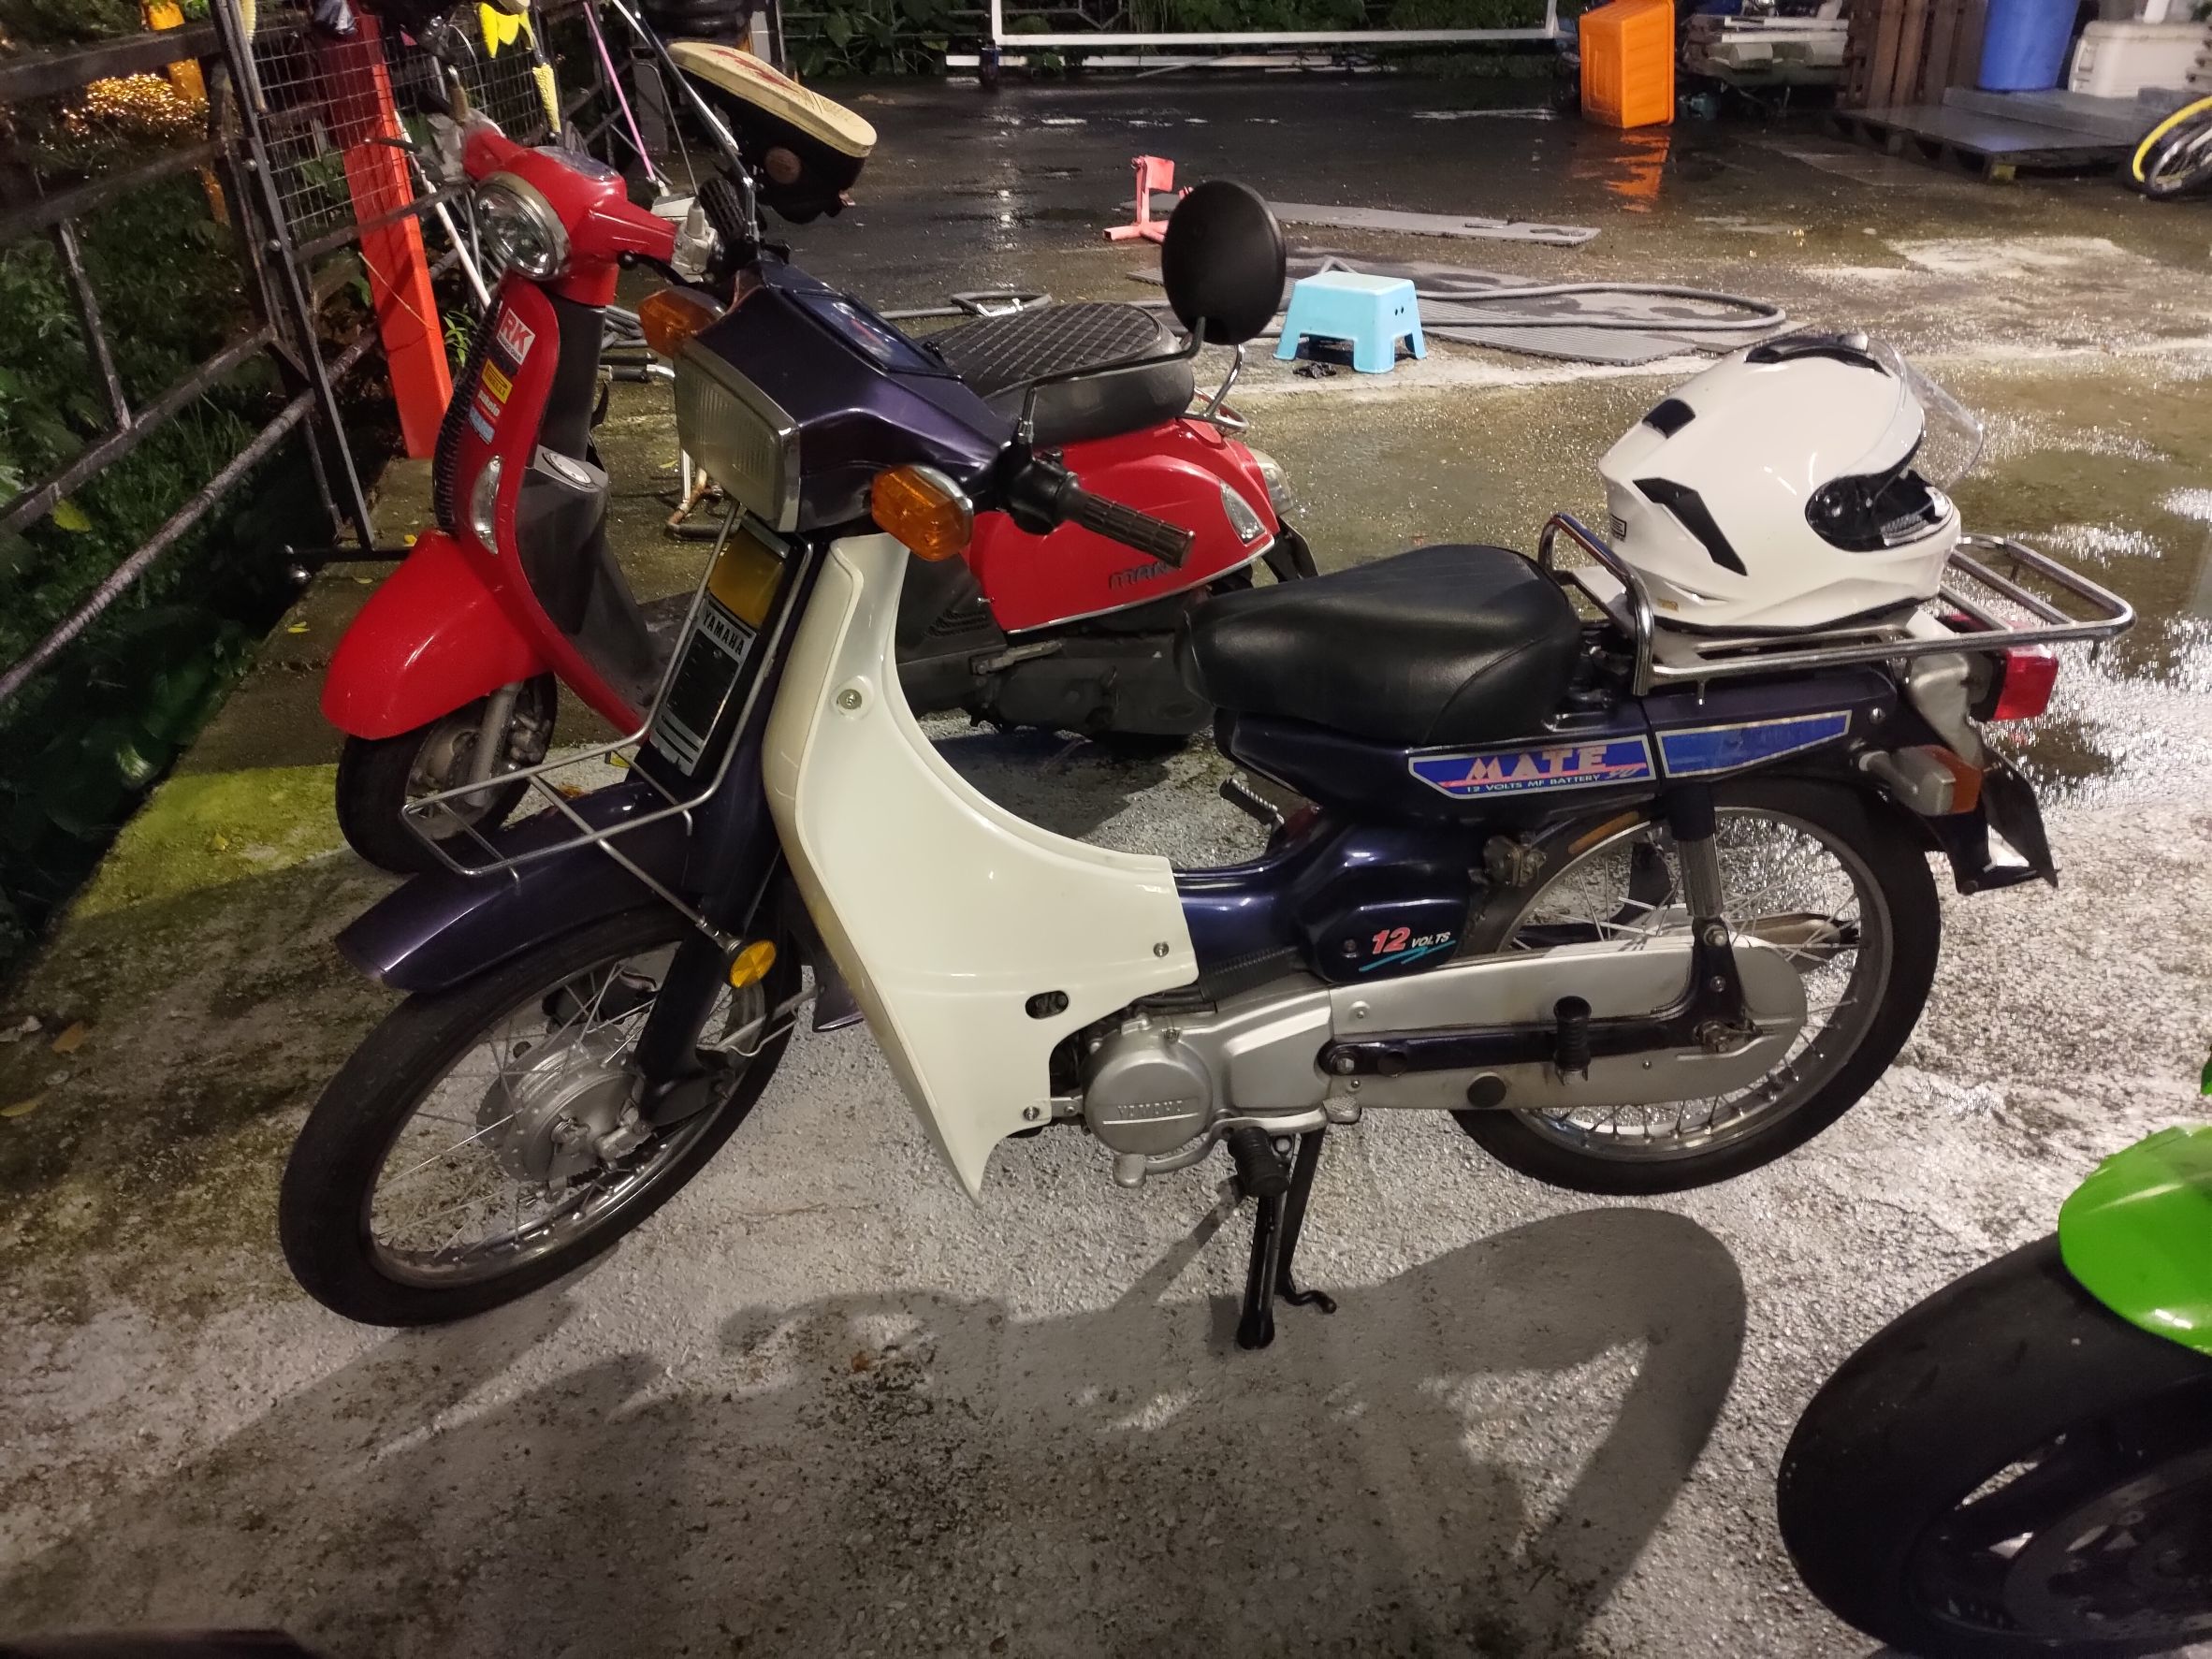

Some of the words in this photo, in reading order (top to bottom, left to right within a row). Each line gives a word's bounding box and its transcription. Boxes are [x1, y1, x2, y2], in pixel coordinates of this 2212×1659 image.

[501, 312, 532, 356] RK
[702, 608, 746, 656] YAMAHA
[1465, 745, 1608, 782] MATE
[1485, 781, 1523, 793] VOLTS
[1527, 779, 1545, 789] MF
[1550, 773, 1601, 786] BATTERY
[1372, 926, 1411, 954] 12
[1411, 932, 1451, 949] VOLTS
